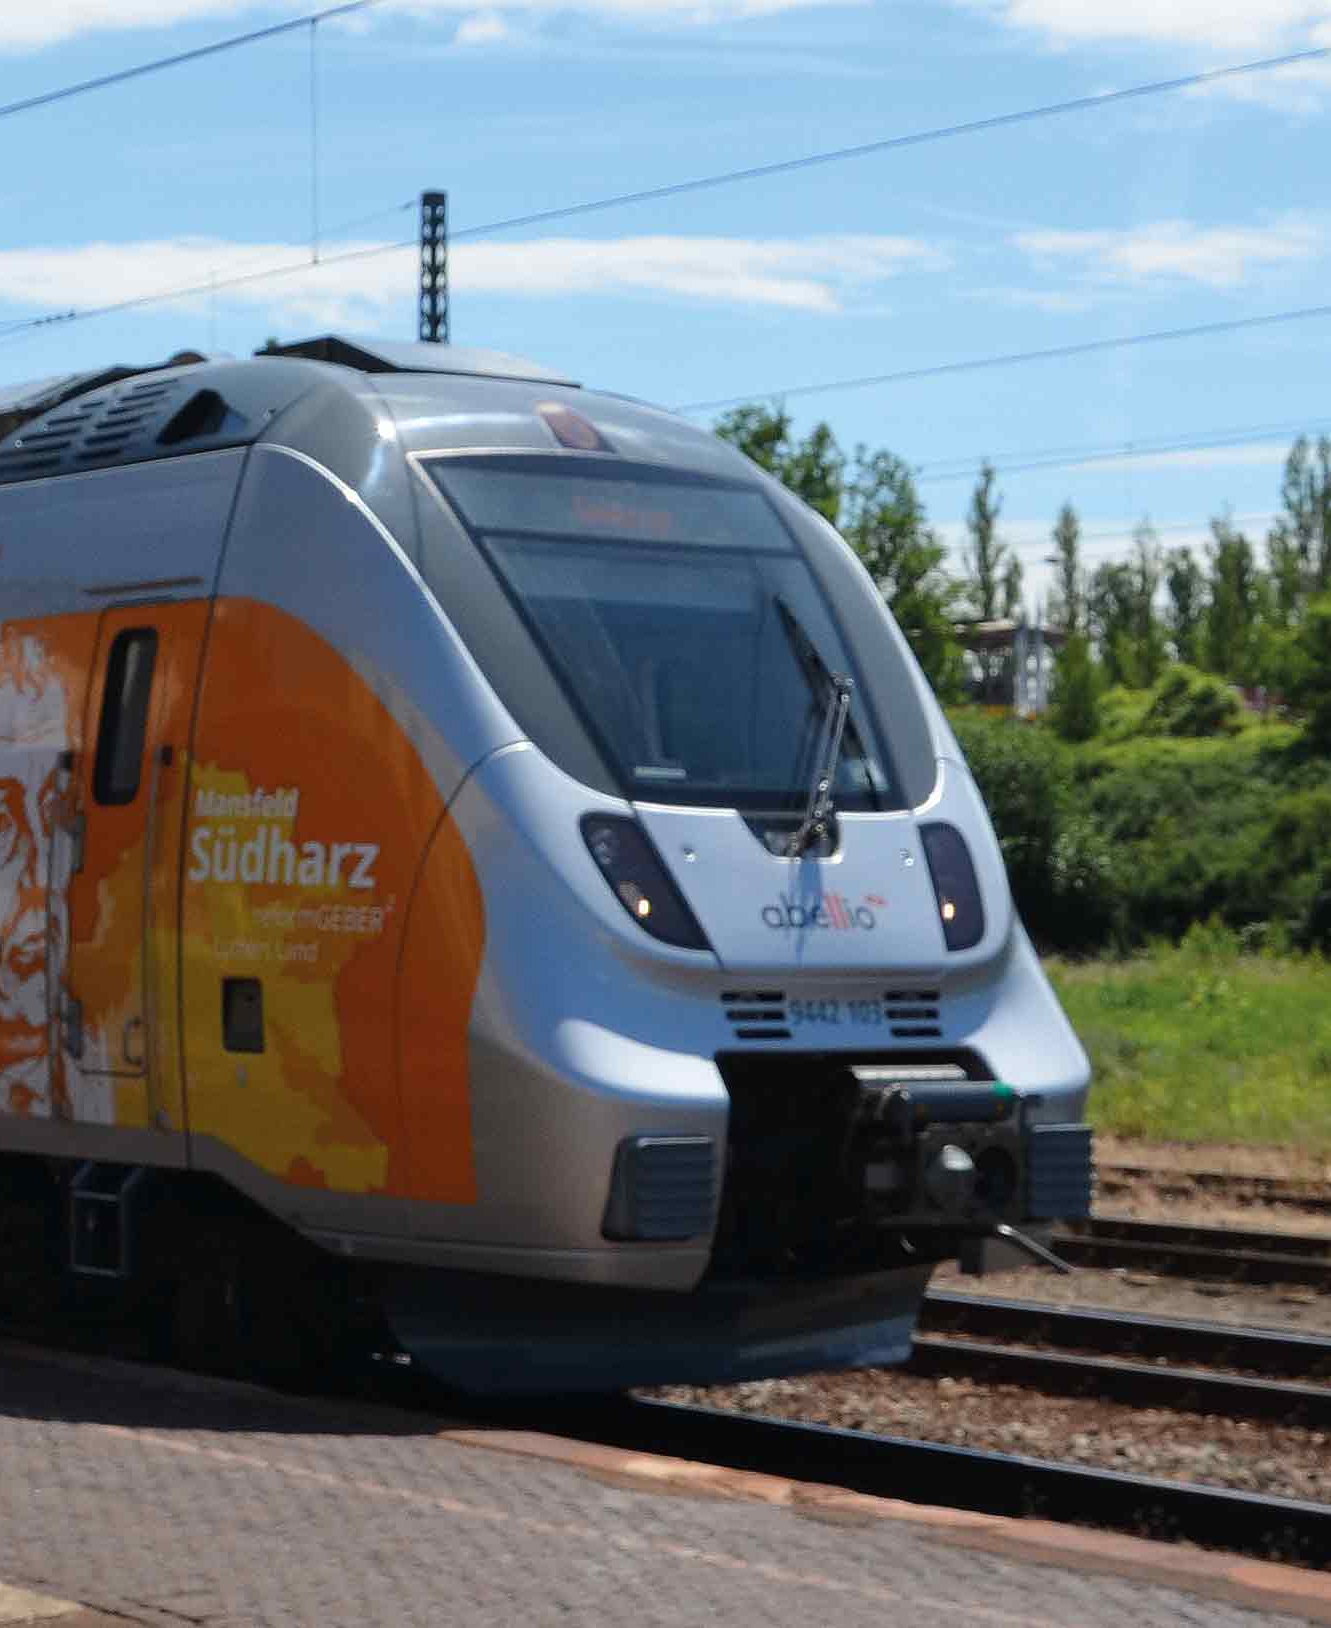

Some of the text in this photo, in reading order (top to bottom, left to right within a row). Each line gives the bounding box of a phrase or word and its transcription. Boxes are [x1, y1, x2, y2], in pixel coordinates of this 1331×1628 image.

[195, 786, 300, 817] Mansfeld
[188, 826, 381, 888] Südharz
[761, 891, 876, 930] abellio
